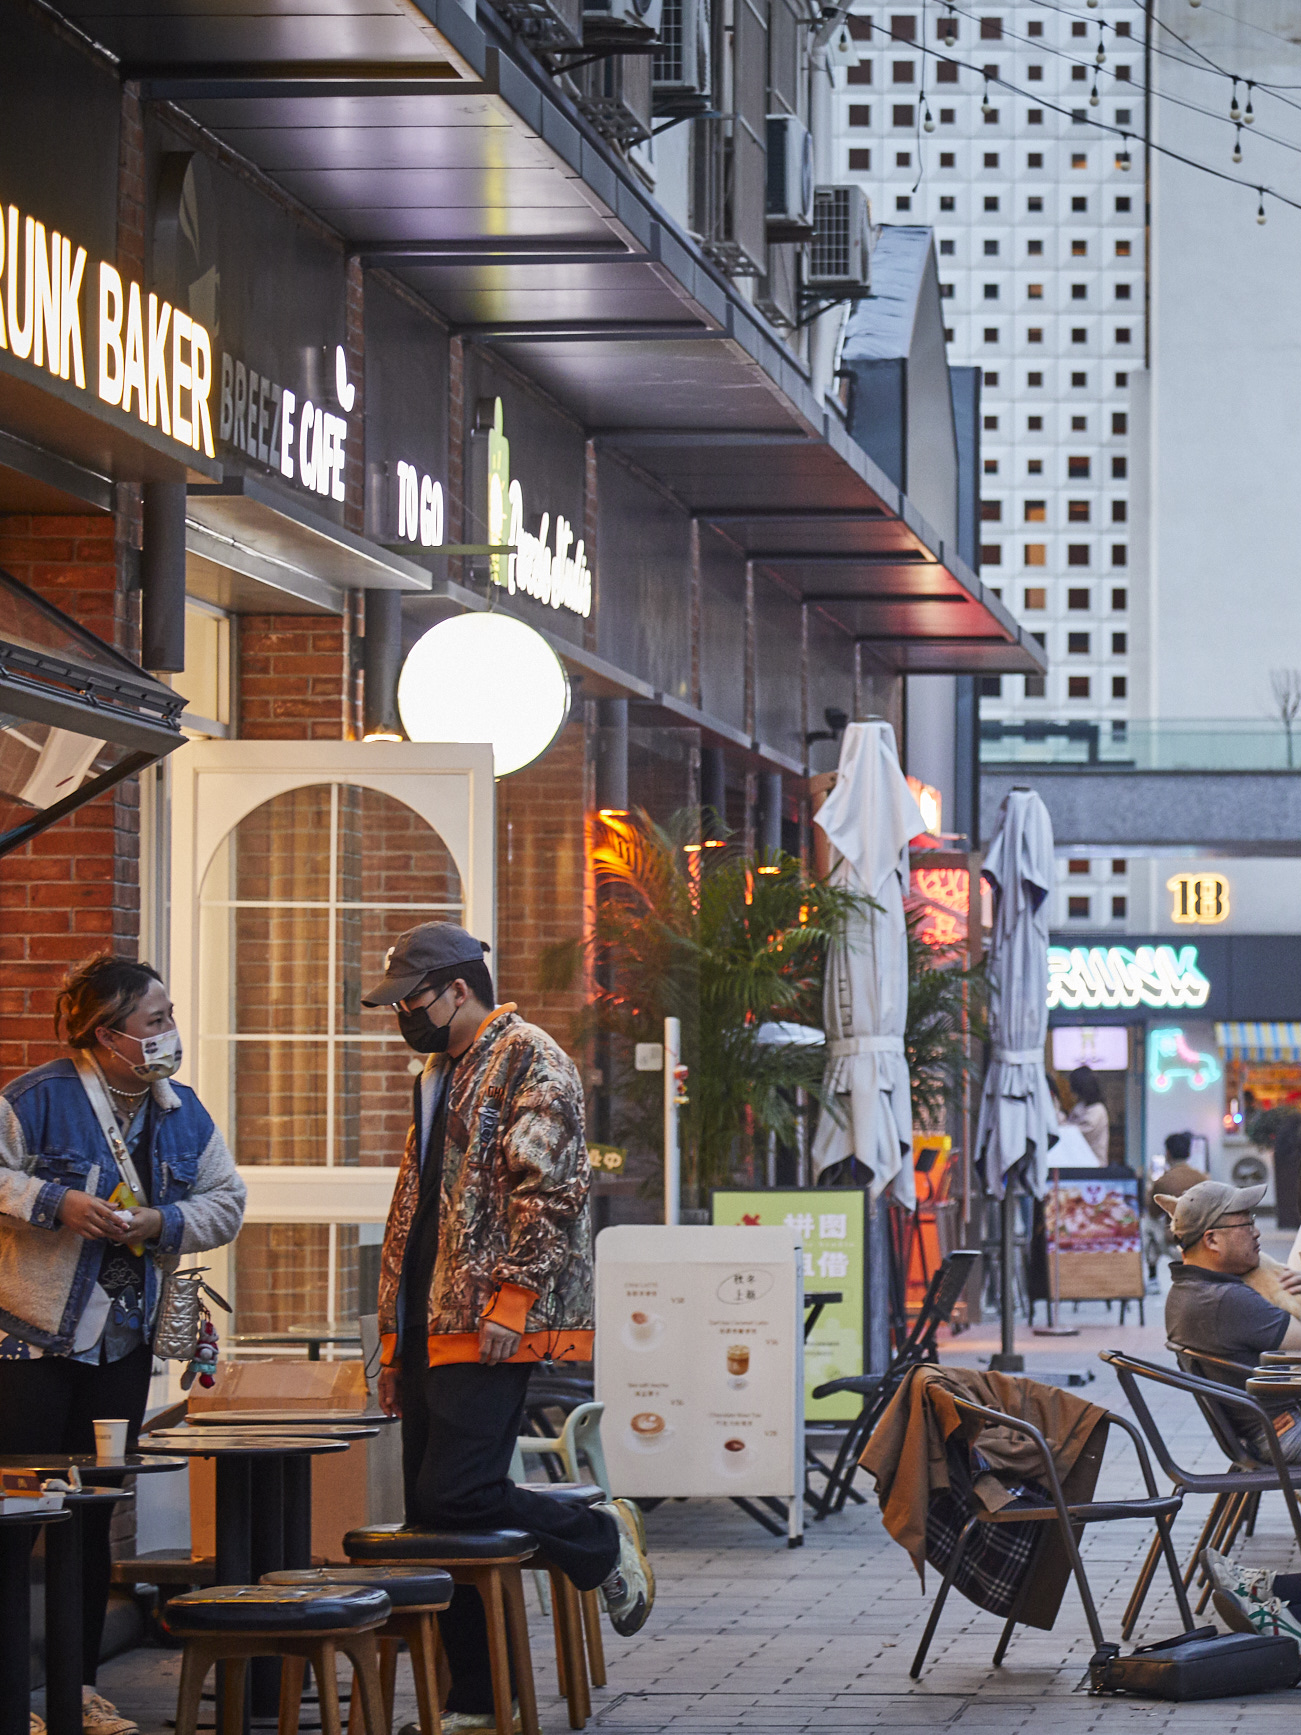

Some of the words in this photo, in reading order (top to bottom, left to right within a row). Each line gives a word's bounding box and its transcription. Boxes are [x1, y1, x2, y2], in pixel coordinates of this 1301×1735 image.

[0, 203, 87, 390] UNK
[99, 260, 216, 459] BAKER
[220, 352, 295, 479] BREEZE
[300, 400, 347, 502] CAFE
[397, 460, 418, 542] TO
[420, 475, 444, 547] GO
[1167, 873, 1230, 924] 18
